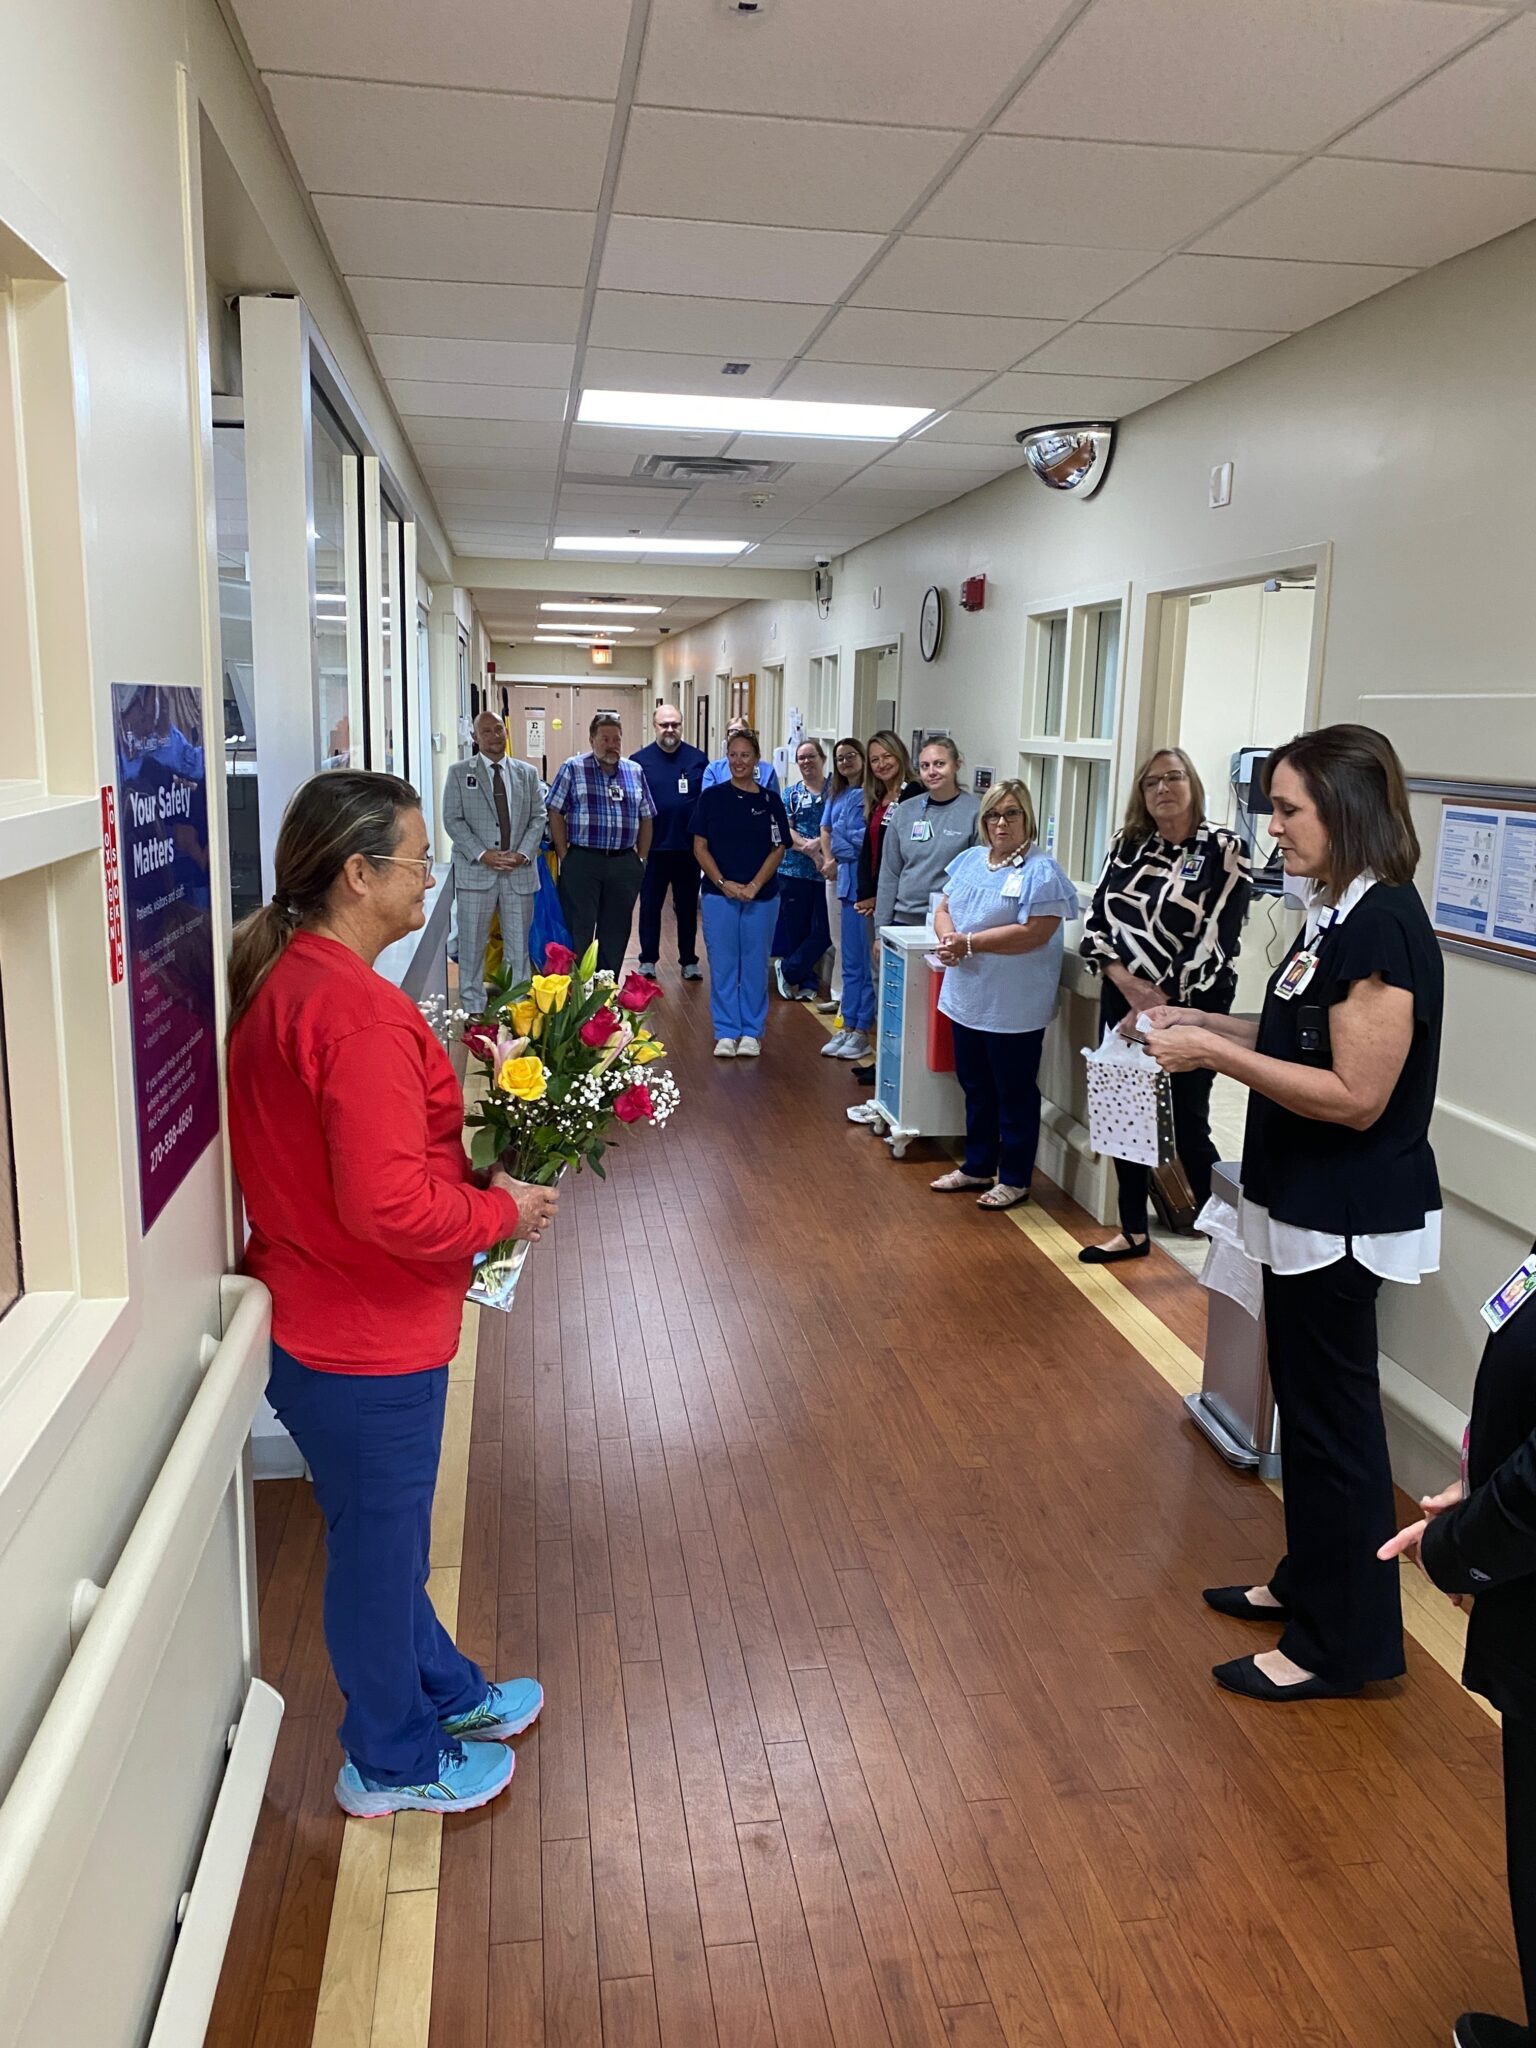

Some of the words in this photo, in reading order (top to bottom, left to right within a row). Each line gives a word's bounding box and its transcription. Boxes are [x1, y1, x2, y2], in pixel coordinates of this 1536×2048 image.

[130, 792, 156, 827] Your
[159, 781, 190, 819] Safety
[133, 837, 174, 878] Matters
[104, 832, 116, 940] OXYGEN
[107, 791, 115, 825] NO
[111, 847, 123, 976] SMOKING
[154, 896, 168, 911] visitors
[146, 1080, 149, 1092] If
[157, 1064, 167, 1080] need
[167, 1056, 175, 1071] help
[176, 1052, 179, 1062] or
[189, 1028, 203, 1048] situation
[147, 1094, 159, 1112] where
[159, 1084, 167, 1098] help
[168, 1078, 171, 1089] is
[148, 1113, 156, 1132] Med
[157, 1102, 169, 1121] Center
[169, 1087, 181, 1106] Health
